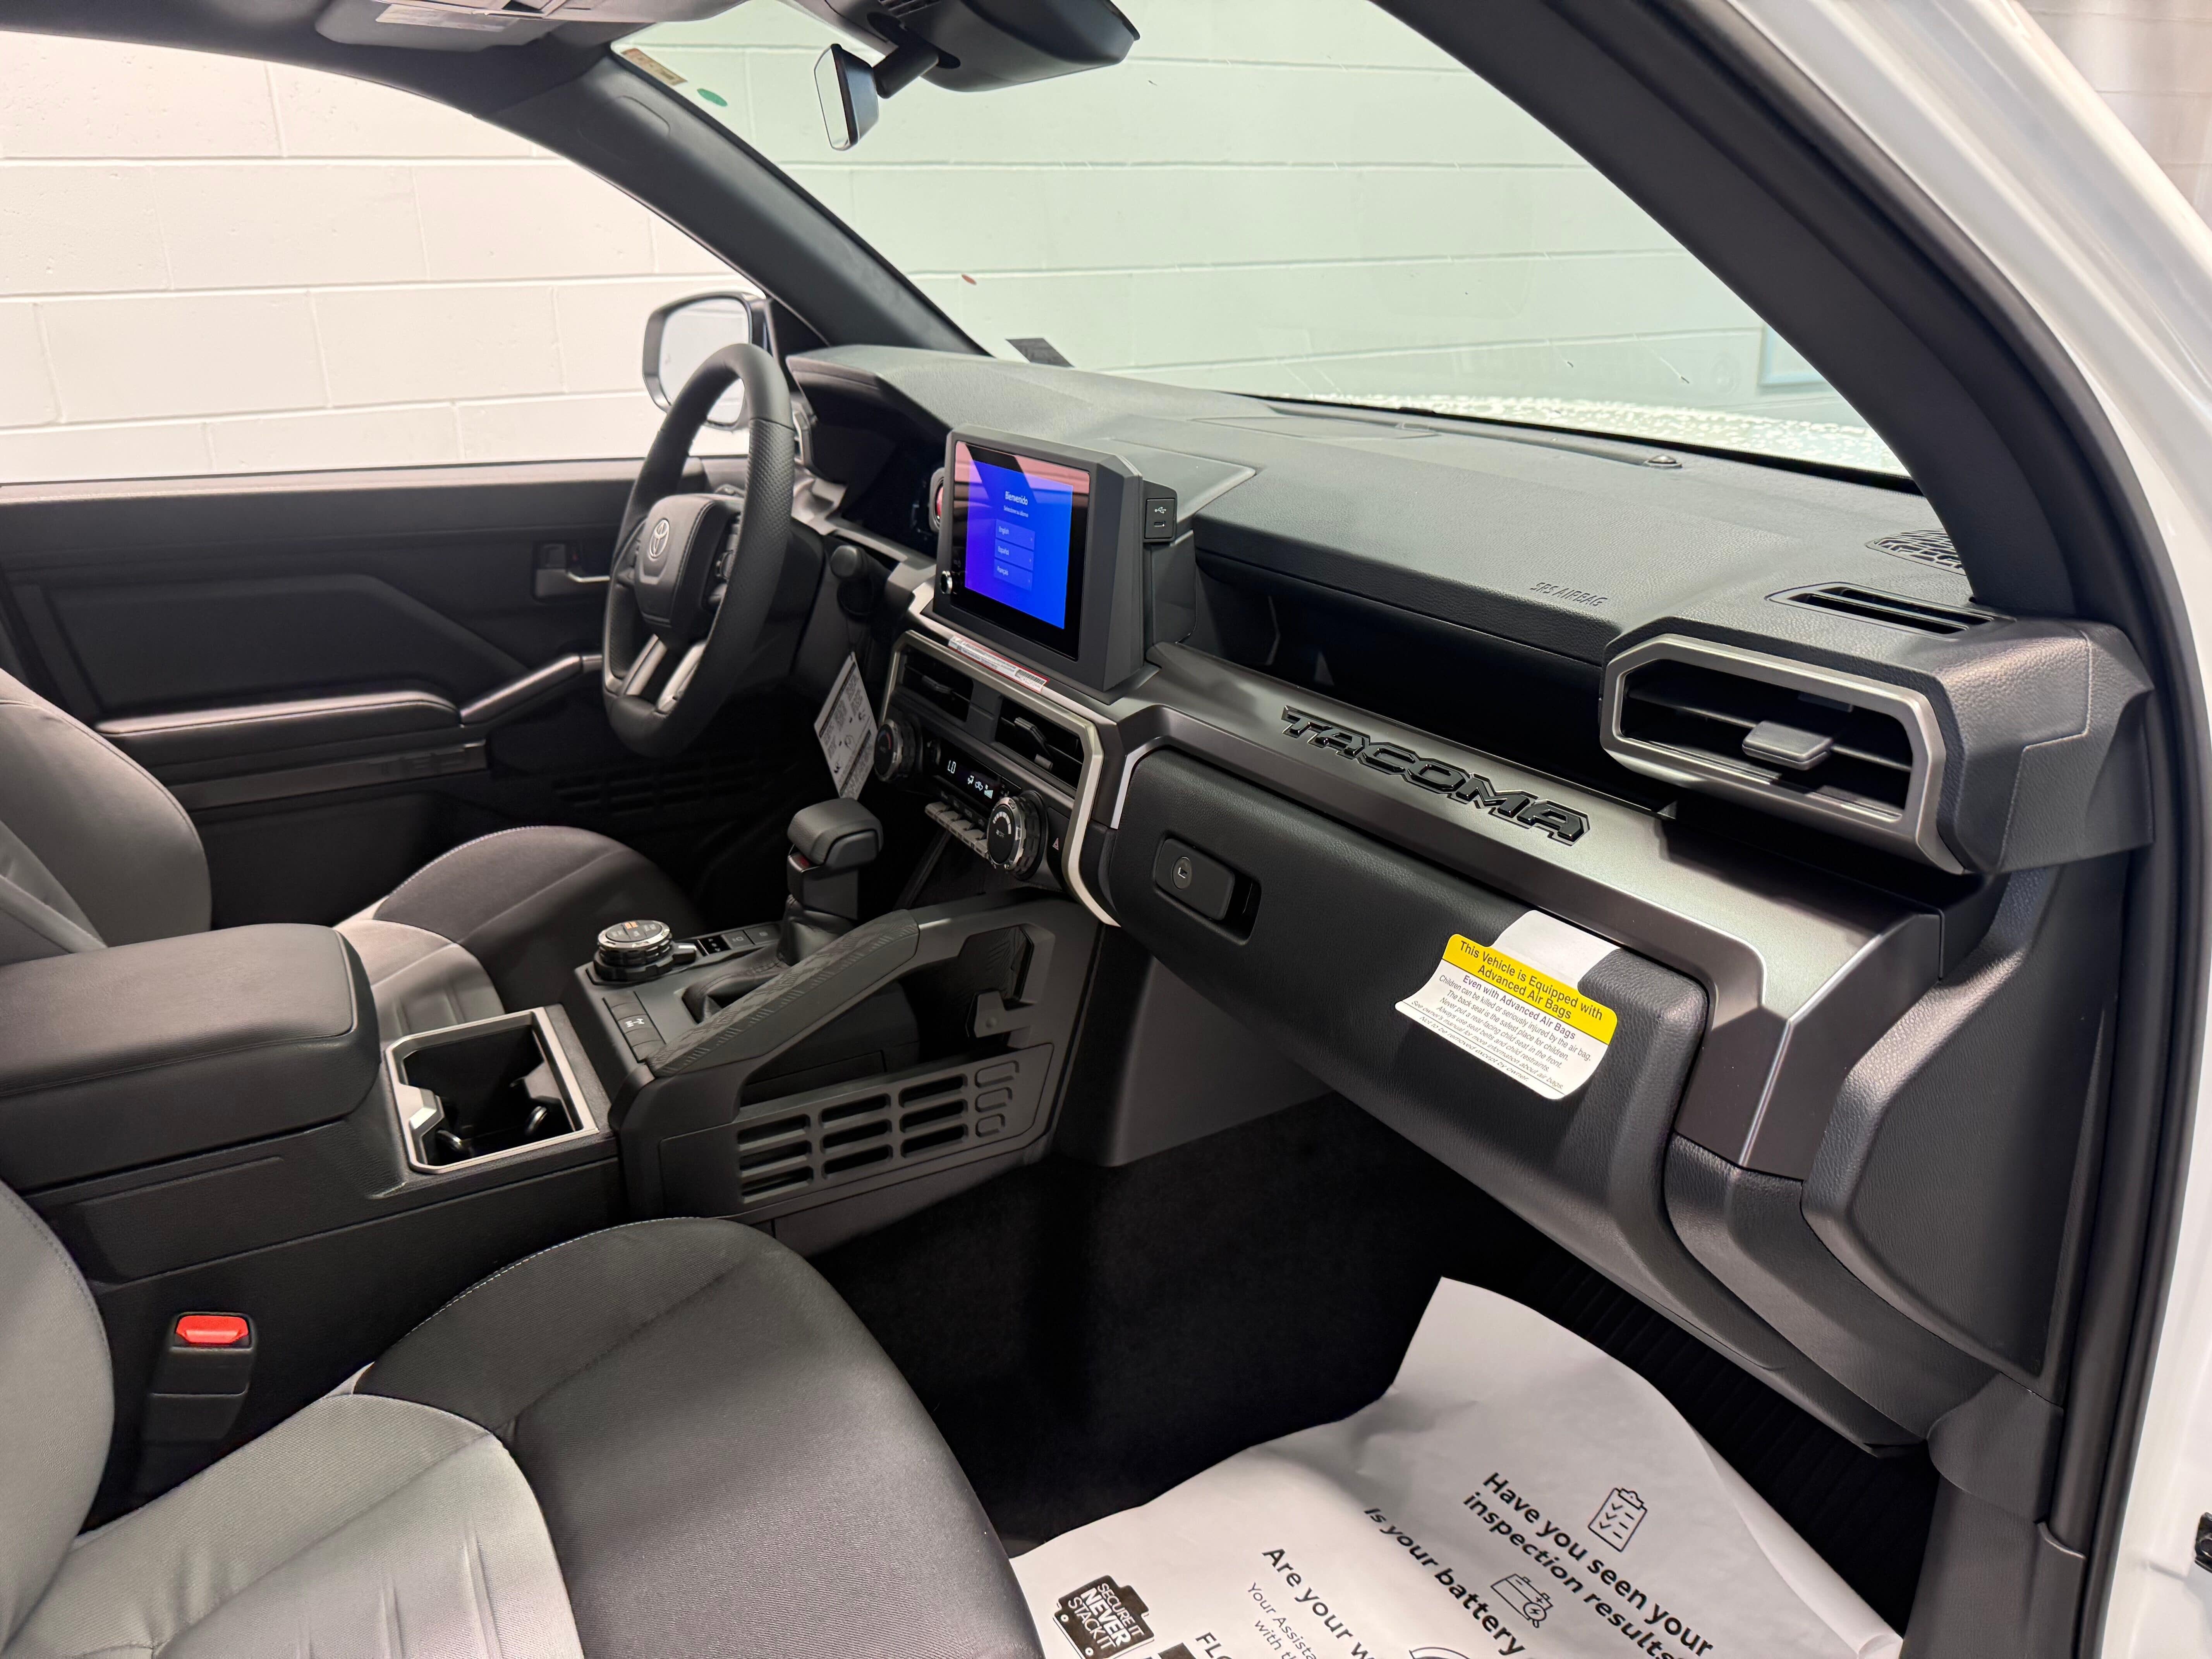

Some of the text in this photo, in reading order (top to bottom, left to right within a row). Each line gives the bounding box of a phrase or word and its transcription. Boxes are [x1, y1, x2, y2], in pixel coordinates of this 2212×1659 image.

[1005, 491, 1028, 505] Bienvenido
[1551, 588, 1607, 606] AIRBAG
[1282, 705, 1590, 846] TACOMA
[1461, 940, 1602, 1021] This Vehicle is Equipped with
[1463, 975, 1576, 1039] Even with Advanced Air Bags
[1478, 965, 1572, 1019] Advanced Air Bags
[1436, 1006, 1457, 1019] Always
[1467, 1023, 1481, 1032] seat
[1480, 1030, 1495, 1041] belts
[1494, 1038, 1508, 1047] and
[1506, 1045, 1522, 1055] child
[1439, 975, 1462, 991] Children
[1462, 988, 1472, 996] can
[1472, 992, 1480, 1001] be
[1480, 996, 1496, 1009] killed
[1502, 1009, 1528, 1027] seriously
[1528, 1022, 1550, 1037] injured
[1549, 1033, 1558, 1043] by
[1558, 1038, 1568, 1048] the
[1568, 1045, 1578, 1053] air
[1577, 1048, 1591, 1061] bag.
[1440, 997, 1457, 1009] Never
[1455, 1007, 1467, 1015] put
[1471, 1015, 1501, 1034] rear-facing
[1501, 1031, 1517, 1042] child
[1515, 1039, 1529, 1049] seat
[1535, 1050, 1546, 1059] the
[1546, 1055, 1563, 1068] front.
[1447, 989, 1458, 1000] The
[1458, 996, 1472, 1007] back
[1471, 1004, 1484, 1014] seat
[1490, 1013, 1500, 1022] the
[1500, 1020, 1518, 1032] safest
[1516, 1029, 1534, 1041] place
[1534, 1037, 1544, 1046] for
[1544, 1044, 1568, 1061] children.
[1463, 1491, 1584, 1594] inspection
[1483, 1472, 1714, 1657] Have you seen your
[1097, 1582, 1145, 1637] SECURE IT
[1247, 1582, 1277, 1615] Your
[1262, 1548, 1302, 1588] Are
[1294, 1587, 1354, 1640] your
[1364, 1507, 1526, 1656] Is your battery
[1068, 1596, 1116, 1650] STACK IT
[1080, 1587, 1132, 1647] NEVER
[1254, 1620, 1283, 1651] with
